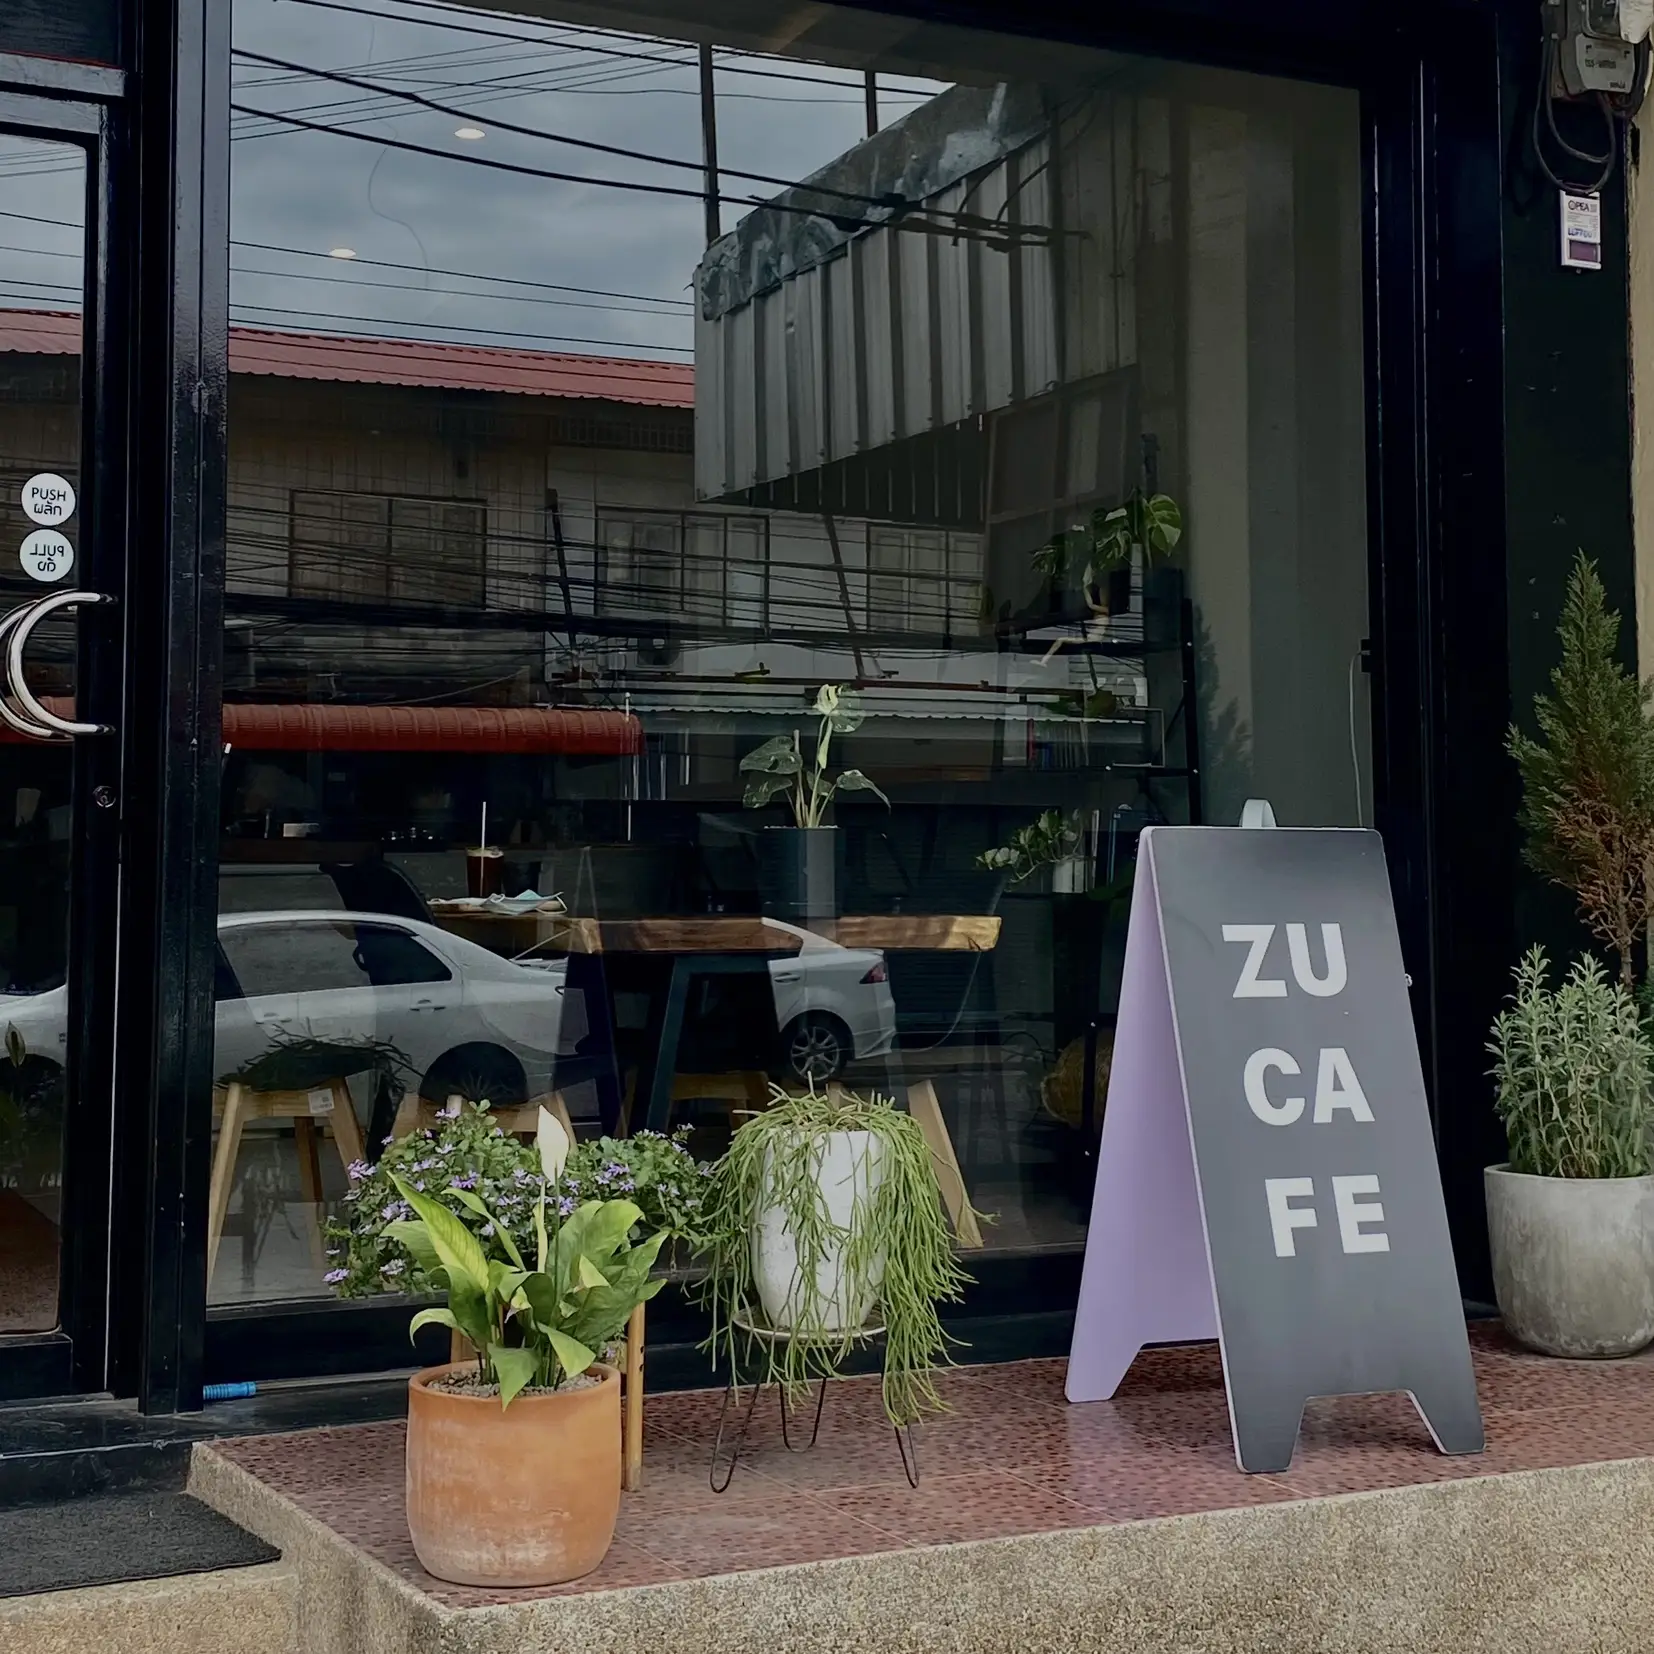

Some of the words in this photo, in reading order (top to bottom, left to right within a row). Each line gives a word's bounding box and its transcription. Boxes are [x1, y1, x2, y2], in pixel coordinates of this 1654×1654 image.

[31, 487, 66, 502] PUSH
[33, 500, 62, 516] ผลัก
[1221, 922, 1348, 998] ZU
[1243, 1047, 1376, 1126] CA
[1264, 1174, 1391, 1258] FE
